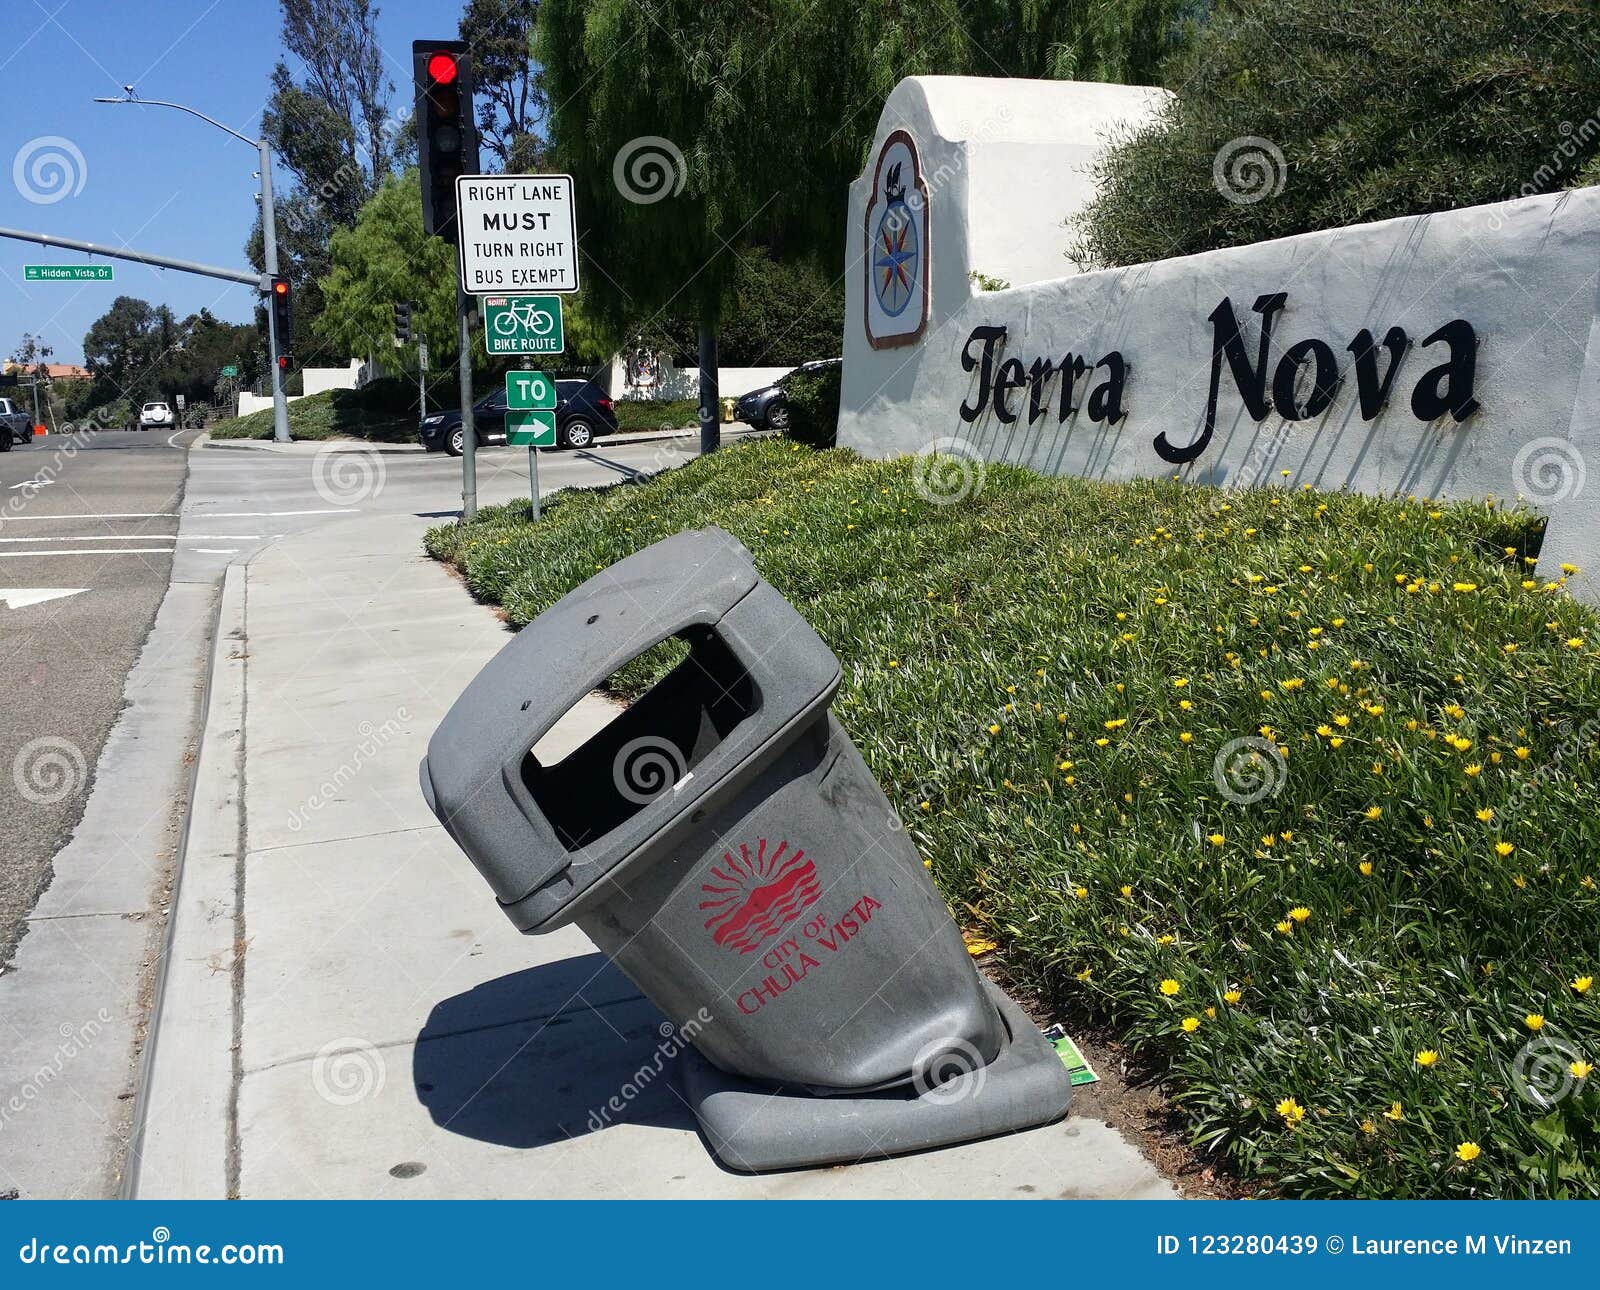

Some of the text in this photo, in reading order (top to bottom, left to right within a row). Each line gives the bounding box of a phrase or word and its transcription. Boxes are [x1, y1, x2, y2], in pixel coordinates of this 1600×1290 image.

[469, 186, 562, 201] RIGHT LANE
[483, 213, 551, 231] MUST
[474, 242, 564, 258] TURN RIGHT
[41, 269, 71, 277] Hidden
[74, 269, 94, 277] Vista
[98, 269, 108, 277] Dr
[475, 269, 566, 284] BUS EXEMPT
[494, 338, 557, 350] BIKE ROUTE
[959, 292, 1481, 464] Terra Nova
[516, 380, 546, 401] TO
[762, 913, 827, 969] CITY OF
[735, 896, 882, 1015] CHULA VISTA
